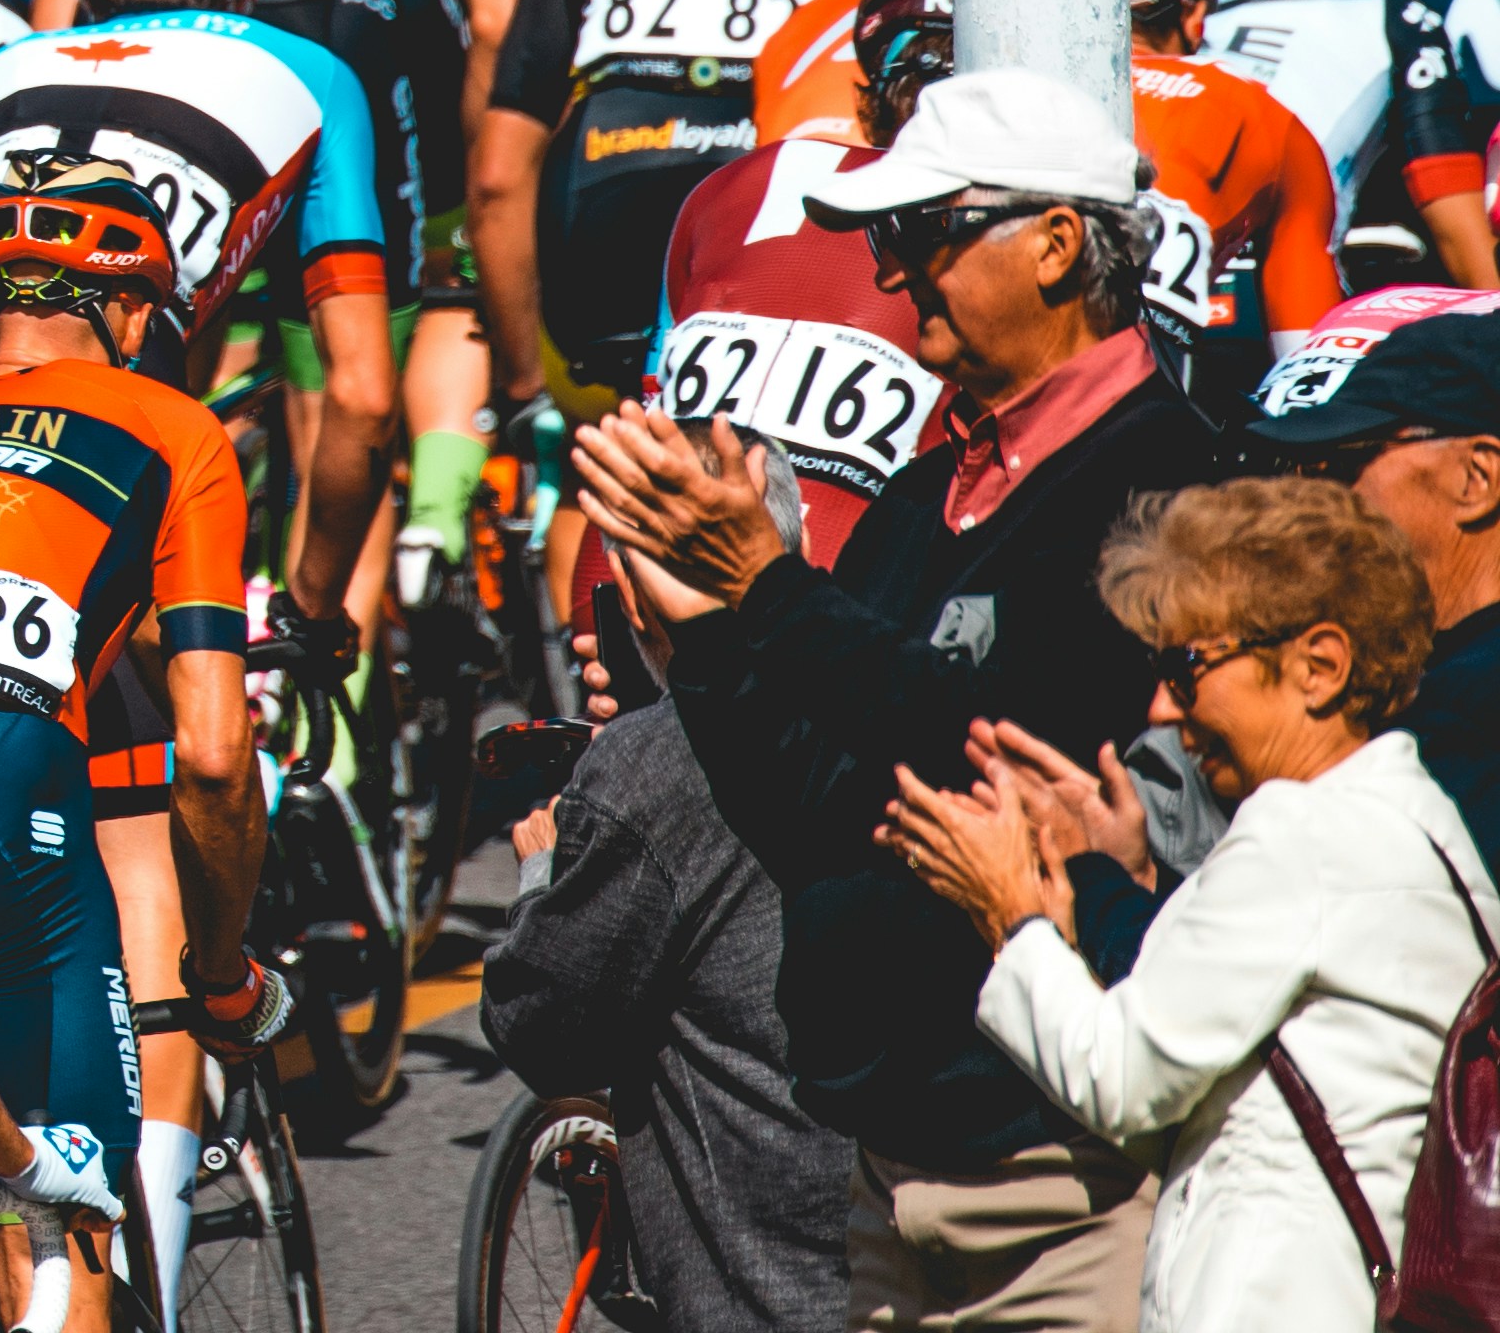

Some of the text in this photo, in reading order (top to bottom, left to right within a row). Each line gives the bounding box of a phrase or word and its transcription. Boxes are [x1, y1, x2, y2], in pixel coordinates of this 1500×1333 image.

[84, 247, 150, 267] RUDY
[785, 345, 915, 464] 162
[102, 966, 143, 1116] MERIDA
